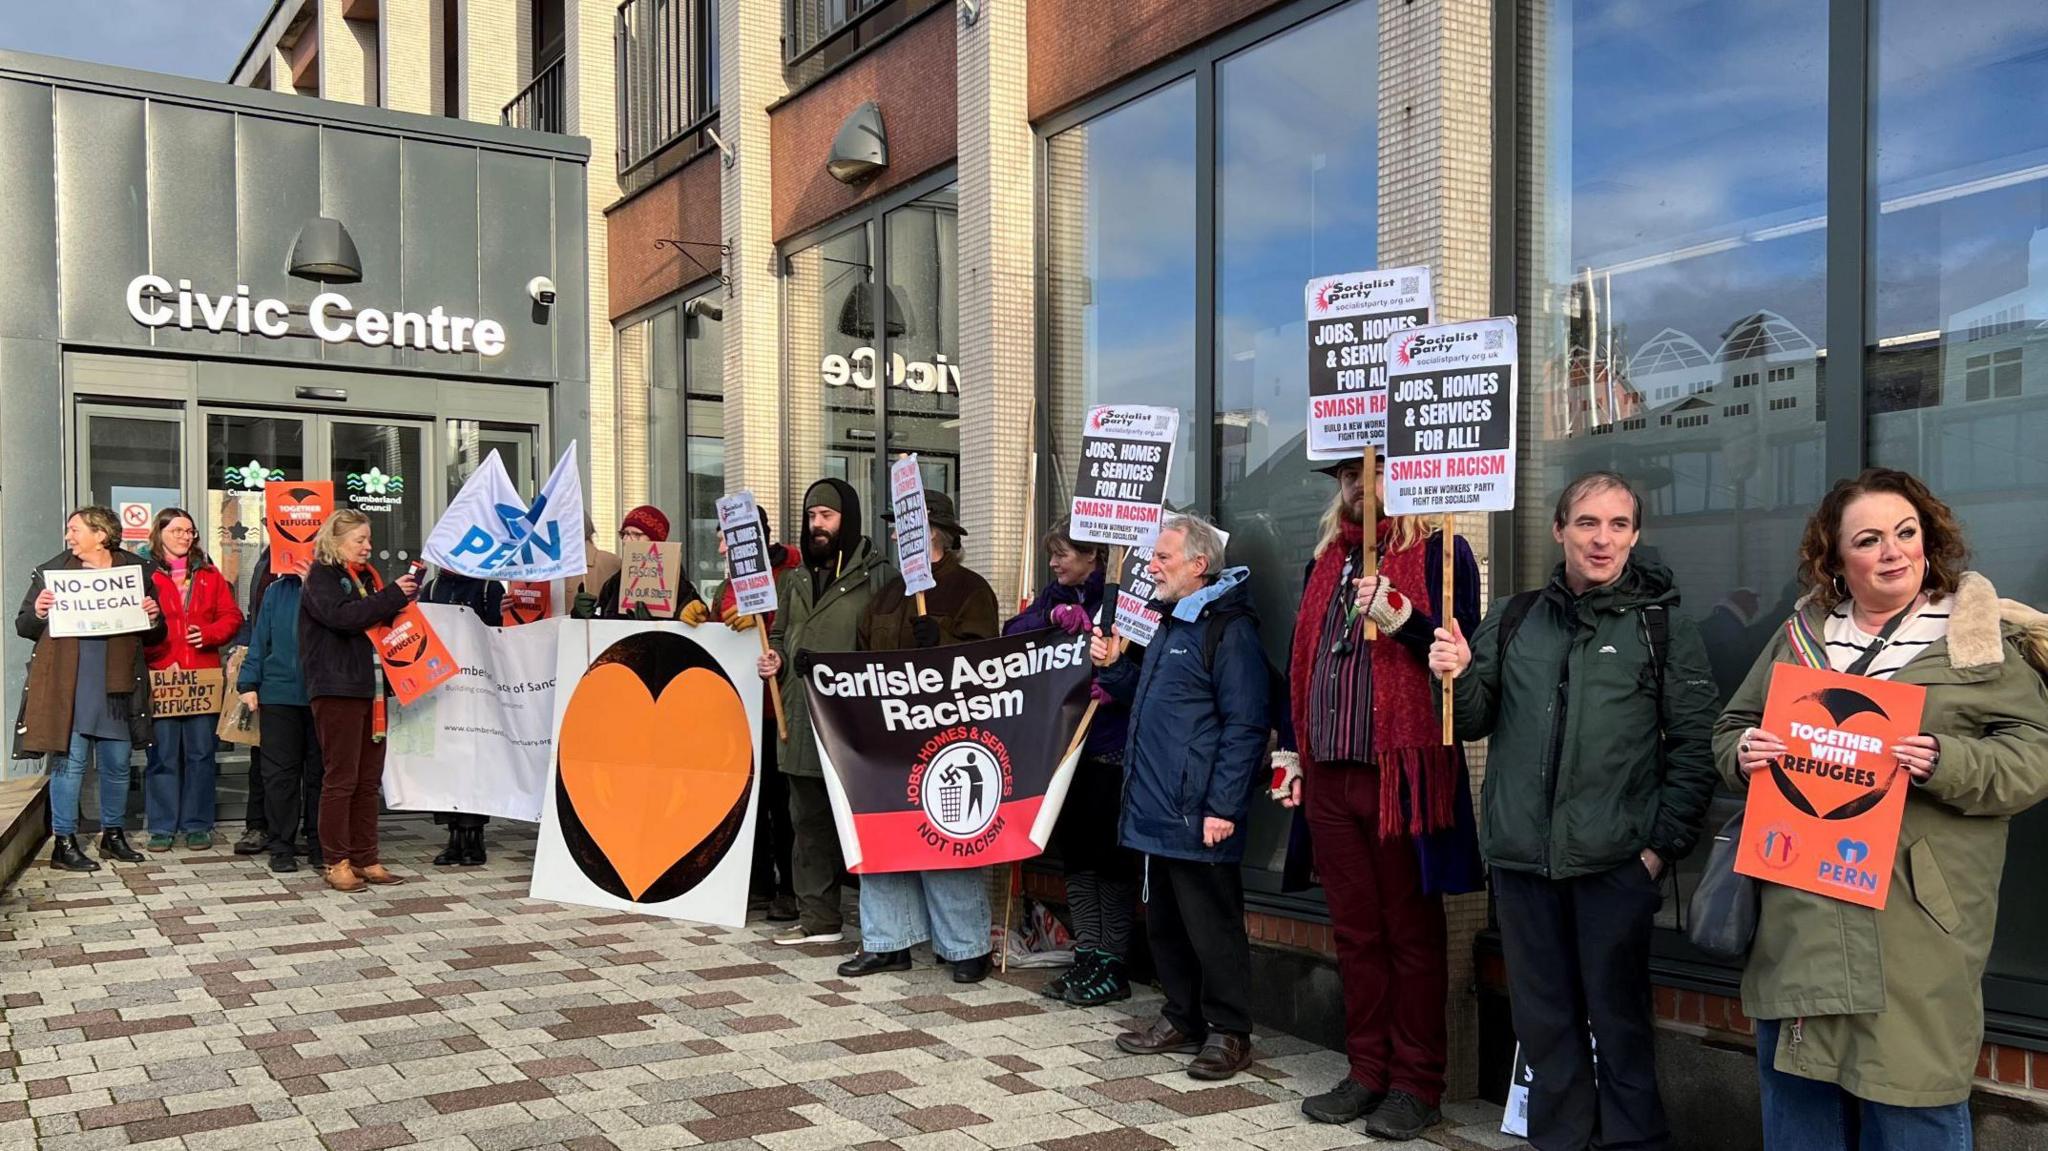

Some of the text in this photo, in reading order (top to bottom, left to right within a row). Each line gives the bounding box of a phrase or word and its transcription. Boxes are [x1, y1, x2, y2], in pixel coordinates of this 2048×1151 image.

[1332, 278, 1396, 294] Socialist
[1335, 296, 1416, 312] socialistparty.org.uk
[126, 274, 506, 357] Civic Centre
[1315, 322, 1359, 346] JOBS,
[1414, 331, 1479, 347] Socialist
[1326, 350, 1337, 368] &
[1417, 352, 1498, 366] socialistparty.org.uk
[1337, 366, 1387, 391] FOR AL
[1394, 372, 1499, 402] JOBS, HOMES
[1105, 409, 1152, 420] Socialist
[1314, 397, 1365, 419] SMASH
[1405, 399, 1492, 427] & SERVICES
[1343, 421, 1347, 431] A
[1349, 420, 1363, 431] NEW
[1364, 418, 1386, 429] WORKE
[1338, 432, 1354, 442] FIGHT
[1356, 431, 1369, 440] FOR
[1415, 425, 1480, 451] FOR ALL!
[1086, 441, 1162, 463] JOBS, HOMES
[1090, 461, 1154, 482] & SERVICES
[1391, 455, 1505, 481] SMASH RACISM
[1095, 480, 1143, 500] FOR ALL!
[1400, 486, 1417, 497] BUILD
[1418, 486, 1423, 495] A
[1424, 485, 1438, 495] NEW
[1474, 482, 1495, 492] PARTY
[279, 505, 322, 513] TOGETHER
[349, 494, 402, 505] Cumberland
[360, 503, 392, 512] Council
[1412, 493, 1480, 506] FIGHT FOR SOCIALISM
[1074, 501, 1159, 522] SMASH RACISM
[280, 519, 322, 527] REFUGEES
[449, 519, 561, 570] PEN
[1131, 563, 1141, 576] &
[54, 575, 136, 593] NO-ONE
[635, 588, 650, 597] OUR
[1130, 579, 1152, 598] FOR
[55, 595, 139, 611] IS ILLEGAL
[386, 632, 421, 658] REFUGEES
[813, 633, 1087, 698] Carlisle Against
[154, 671, 198, 686] BLAME
[513, 682, 524, 694] of
[152, 684, 216, 699] CUTS NOT
[153, 697, 212, 714] REFUGEES
[880, 688, 1025, 732] Racism
[1790, 721, 1884, 754] TOGETHER
[917, 726, 968, 762] HOMES
[969, 727, 979, 740] &
[980, 730, 1014, 797] SERVICES
[1810, 742, 1857, 767] WITH
[1783, 754, 1876, 788] REFUGEES
[917, 816, 1006, 857] NOT RACISM
[1818, 860, 1878, 891] PERN
